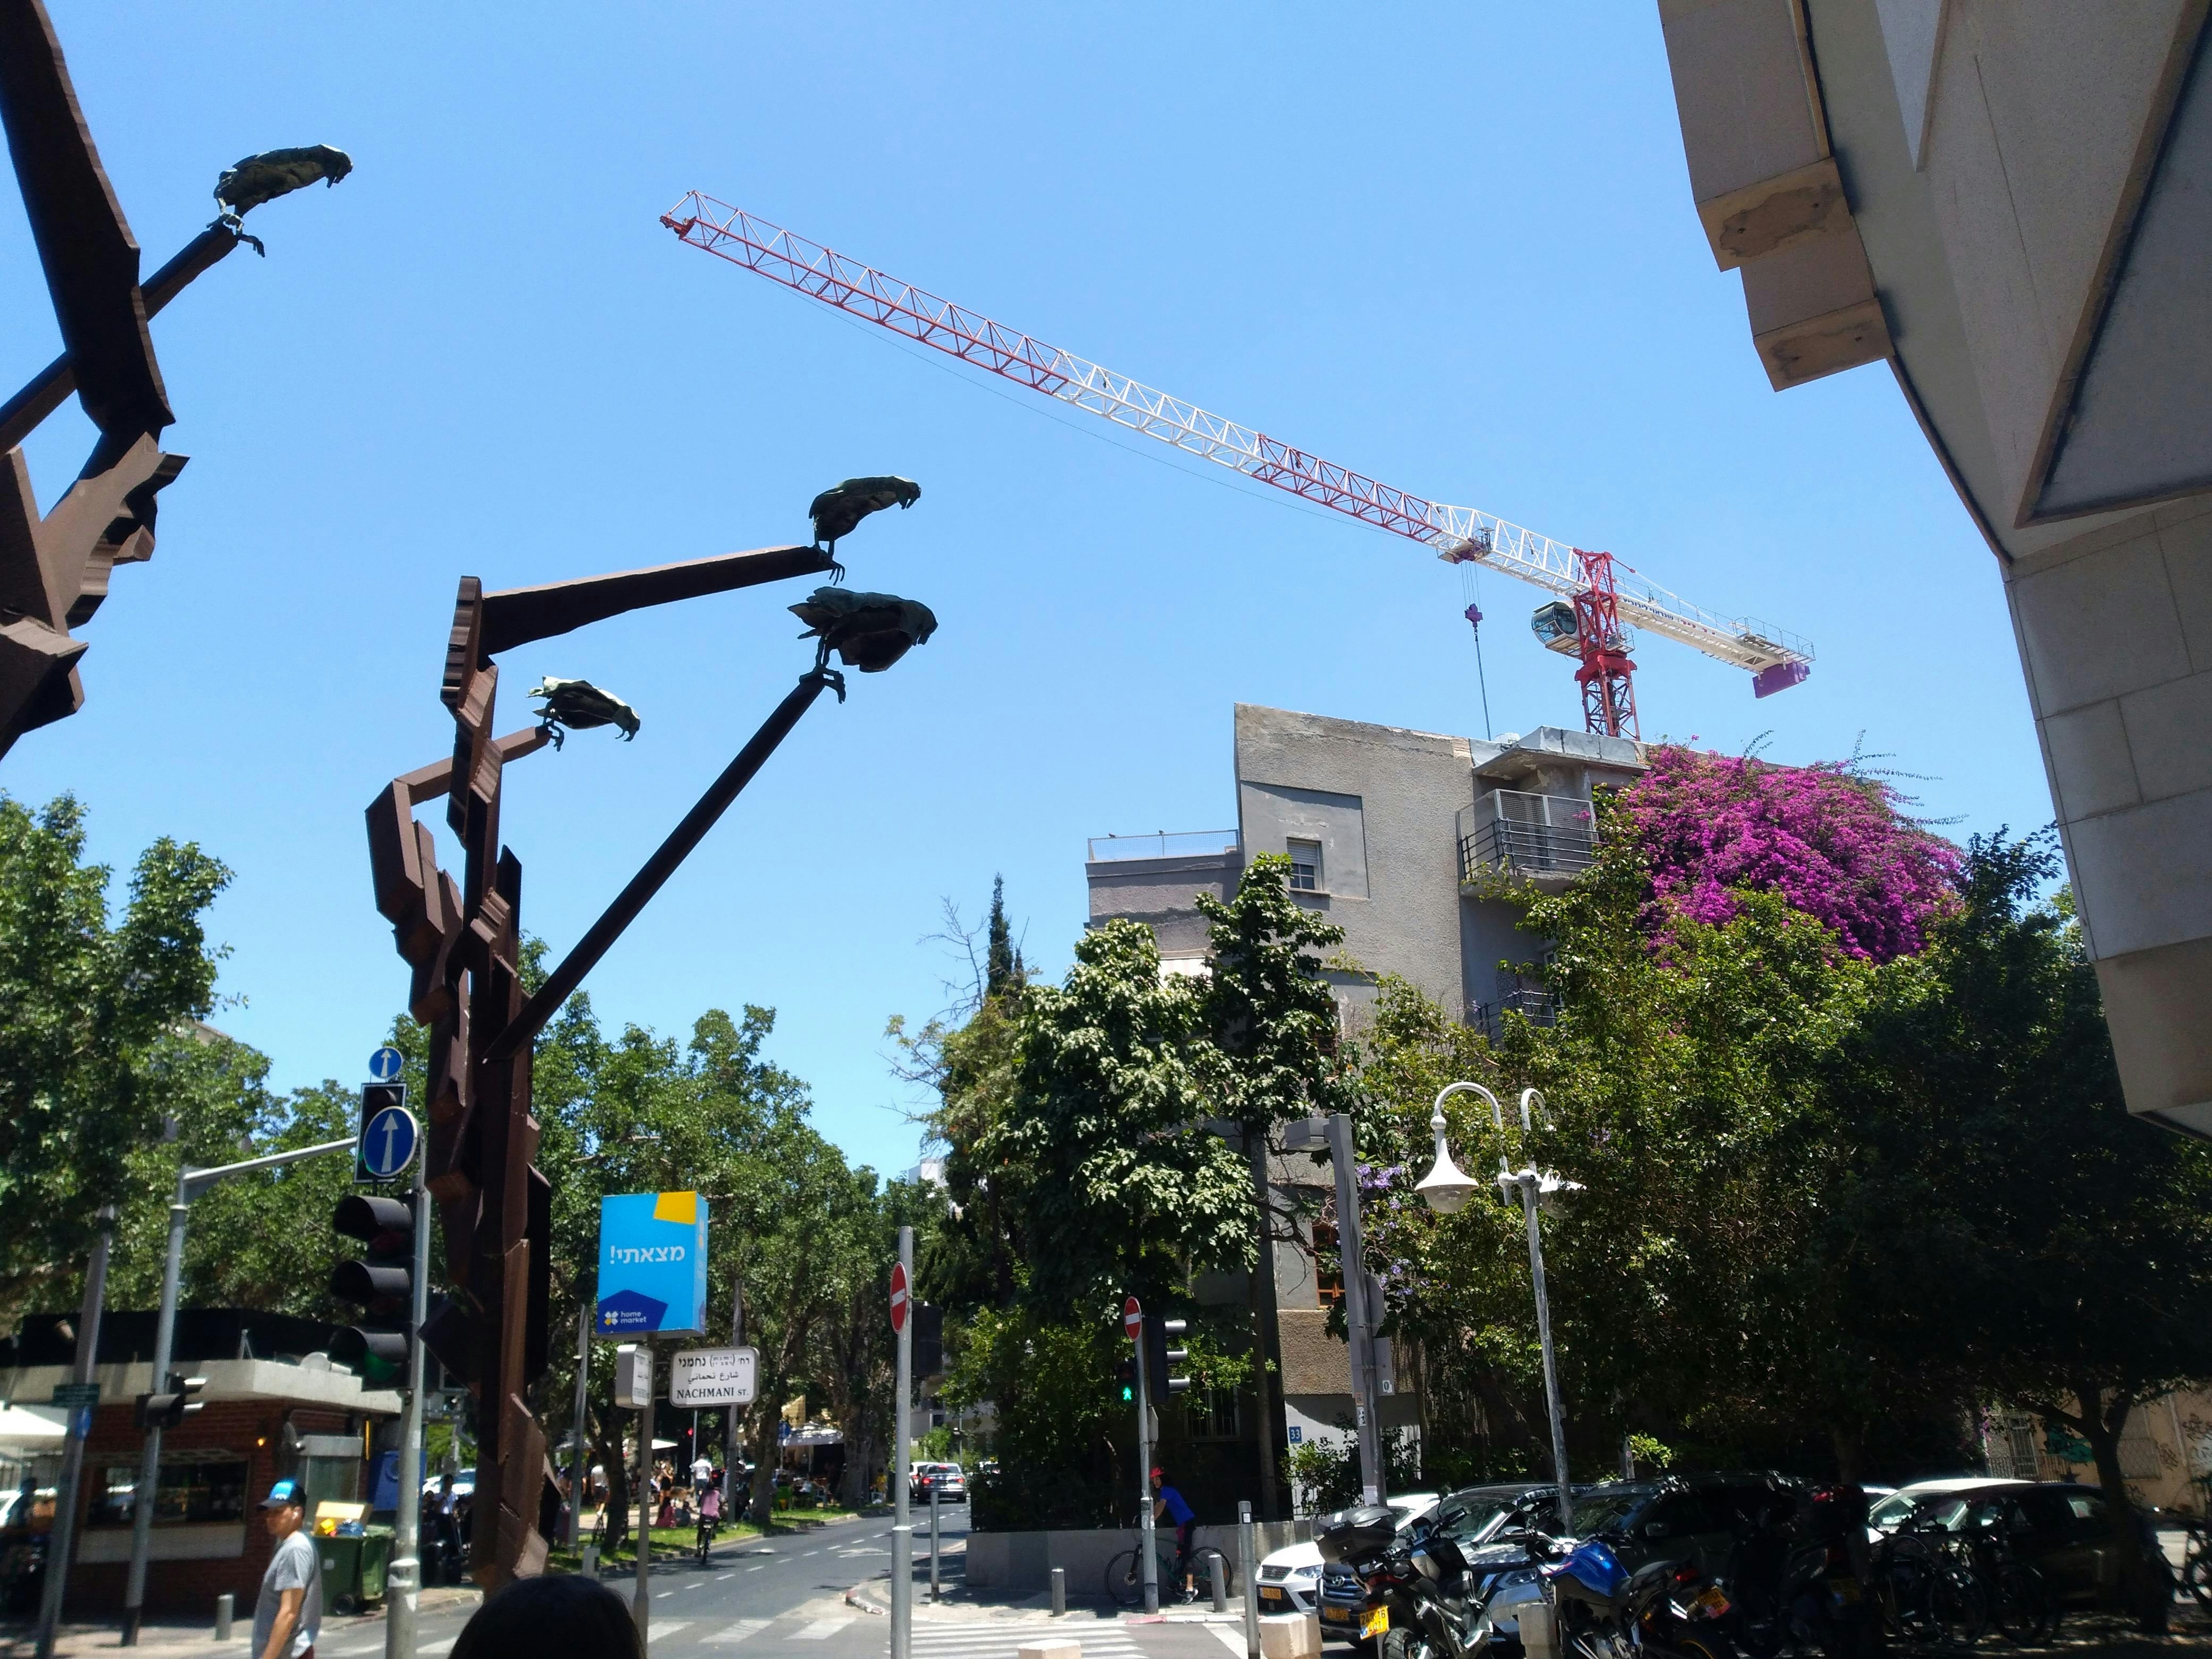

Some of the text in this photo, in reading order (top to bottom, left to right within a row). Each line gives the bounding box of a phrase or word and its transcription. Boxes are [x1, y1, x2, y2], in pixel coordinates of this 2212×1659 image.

[610, 1245, 685, 1264] מצאתי!
[678, 1356, 706, 1368] נחמני
[688, 1371, 739, 1385] شارع نحماني
[676, 1387, 734, 1399] NACHMANI
[1290, 1429, 1301, 1439] 33
